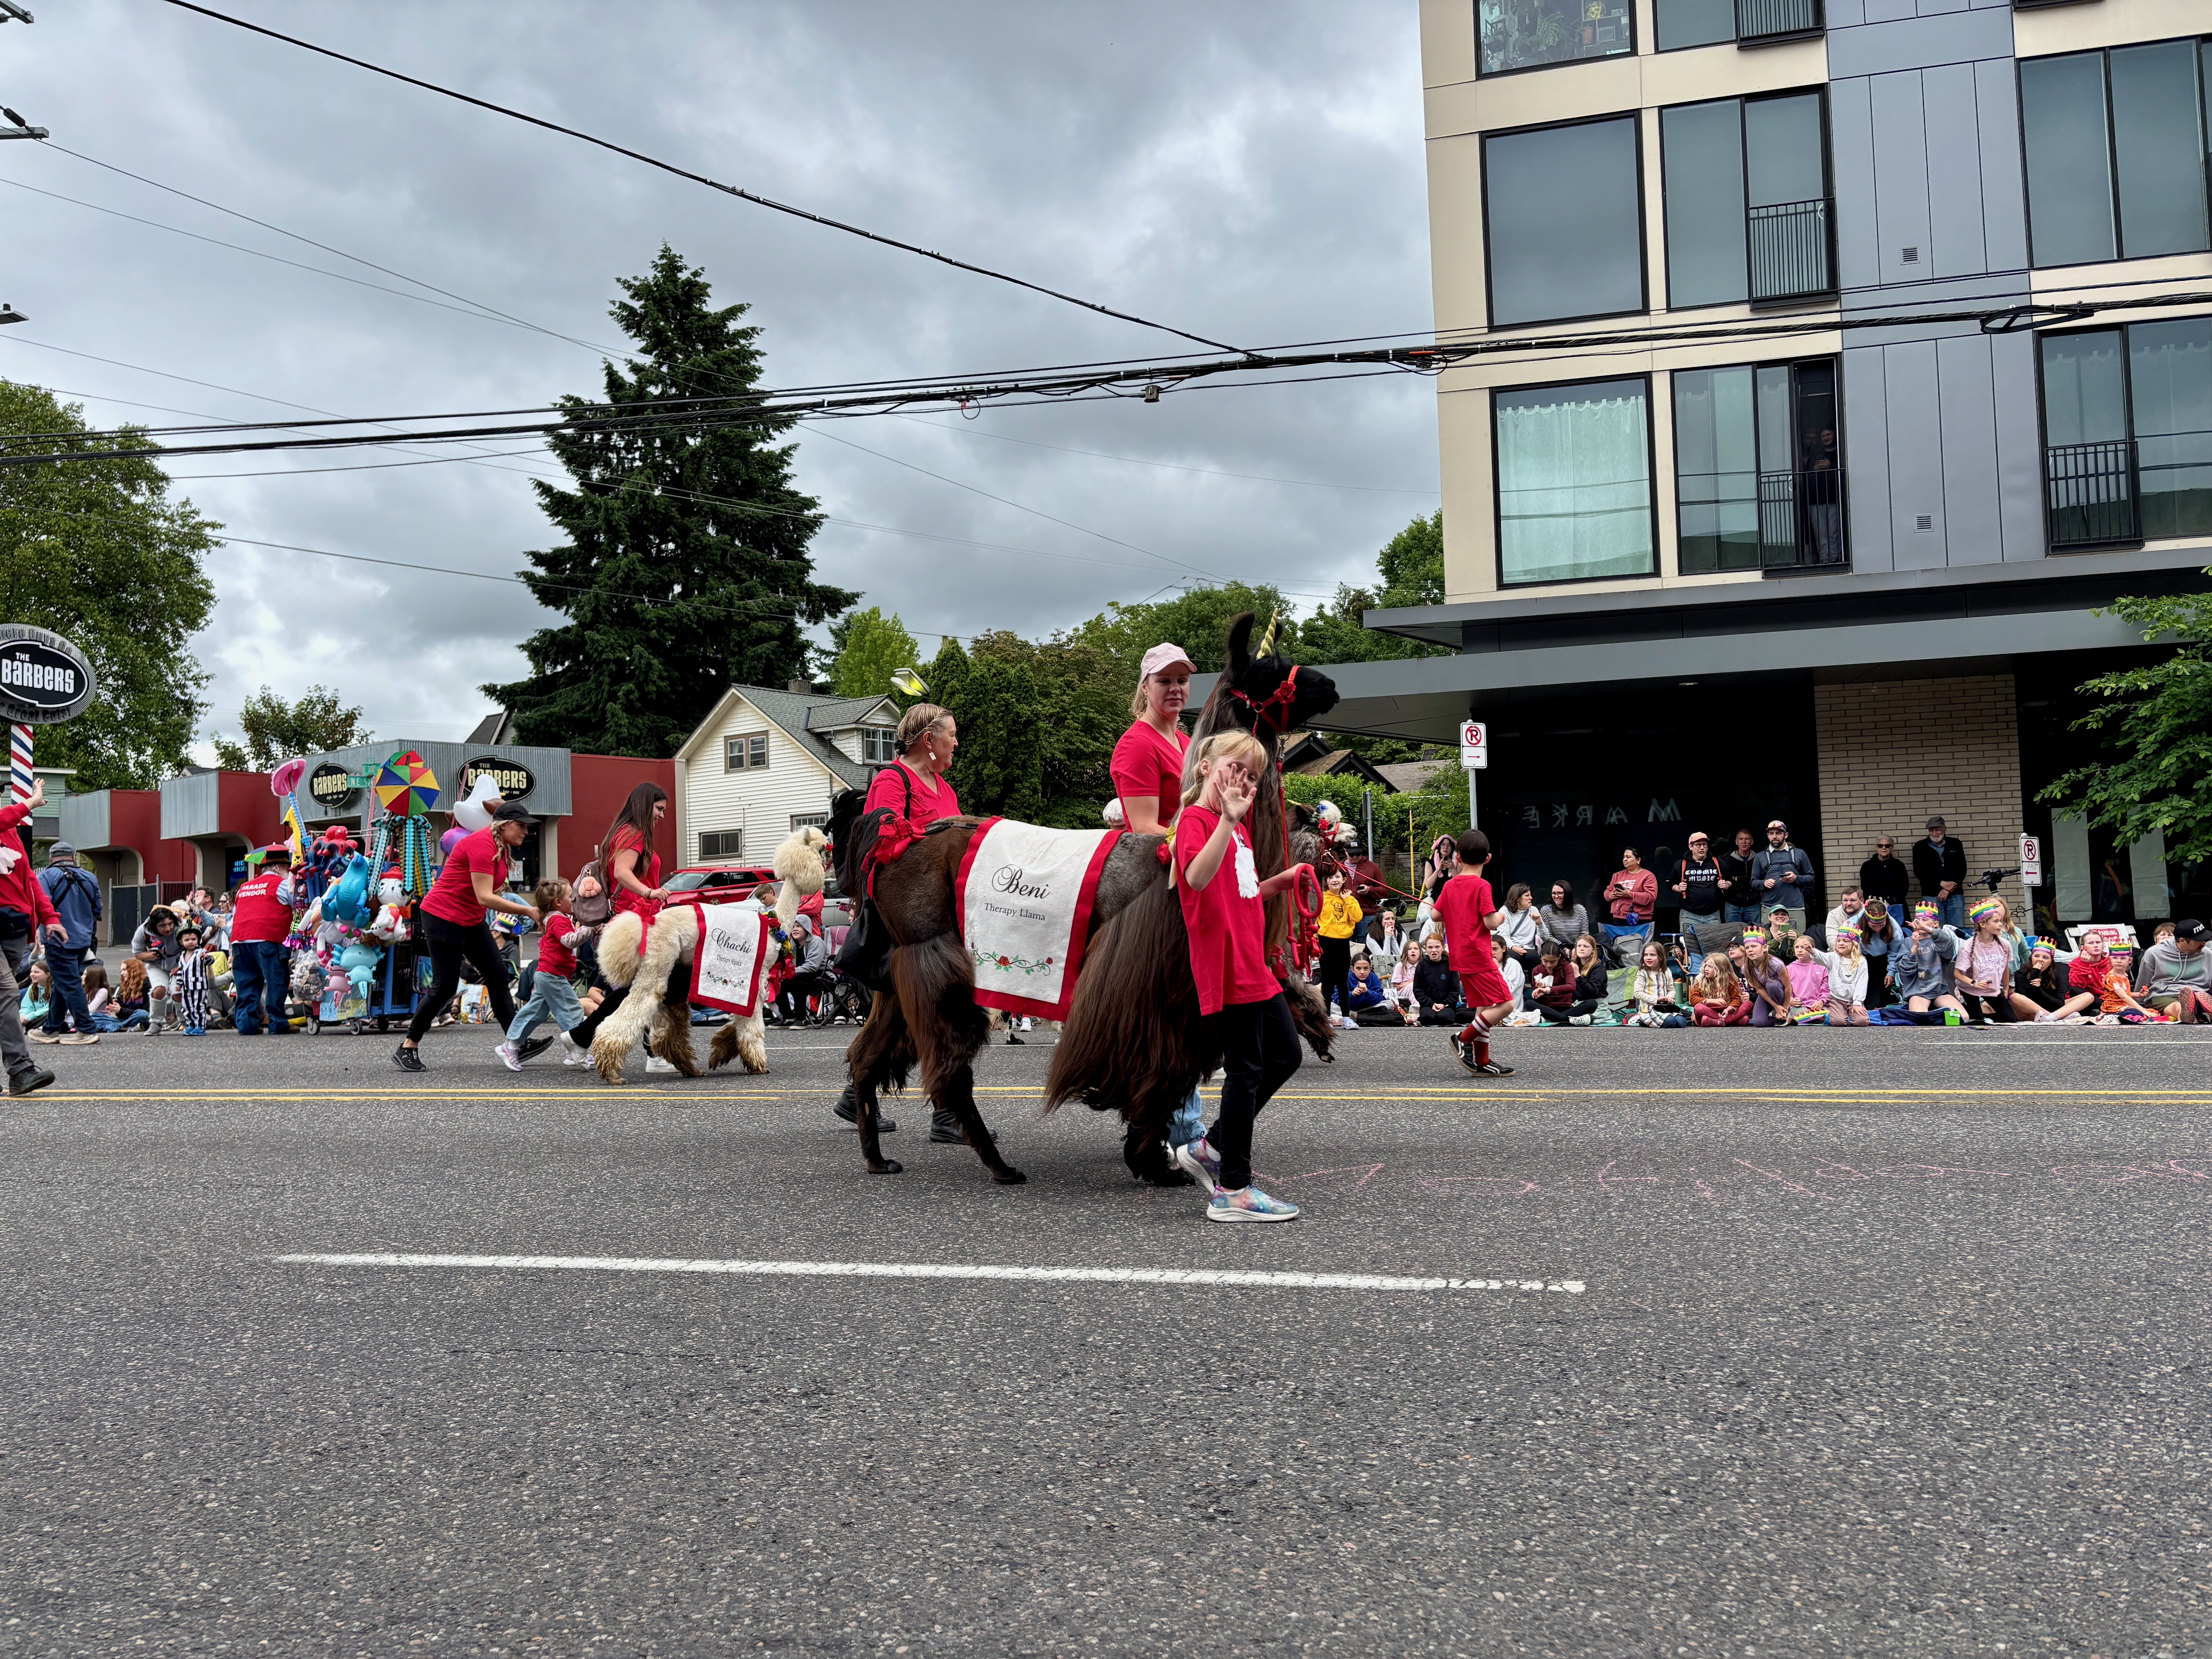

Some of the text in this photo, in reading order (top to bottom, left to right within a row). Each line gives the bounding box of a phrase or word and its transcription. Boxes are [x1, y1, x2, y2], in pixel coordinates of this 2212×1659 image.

[15, 652, 30, 661] THE
[992, 864, 1050, 899] Beni
[239, 889, 266, 898] VENDOR
[985, 903, 1045, 921] Therapy Llama
[711, 928, 752, 953] Chachi
[716, 954, 731, 965] Therapy
